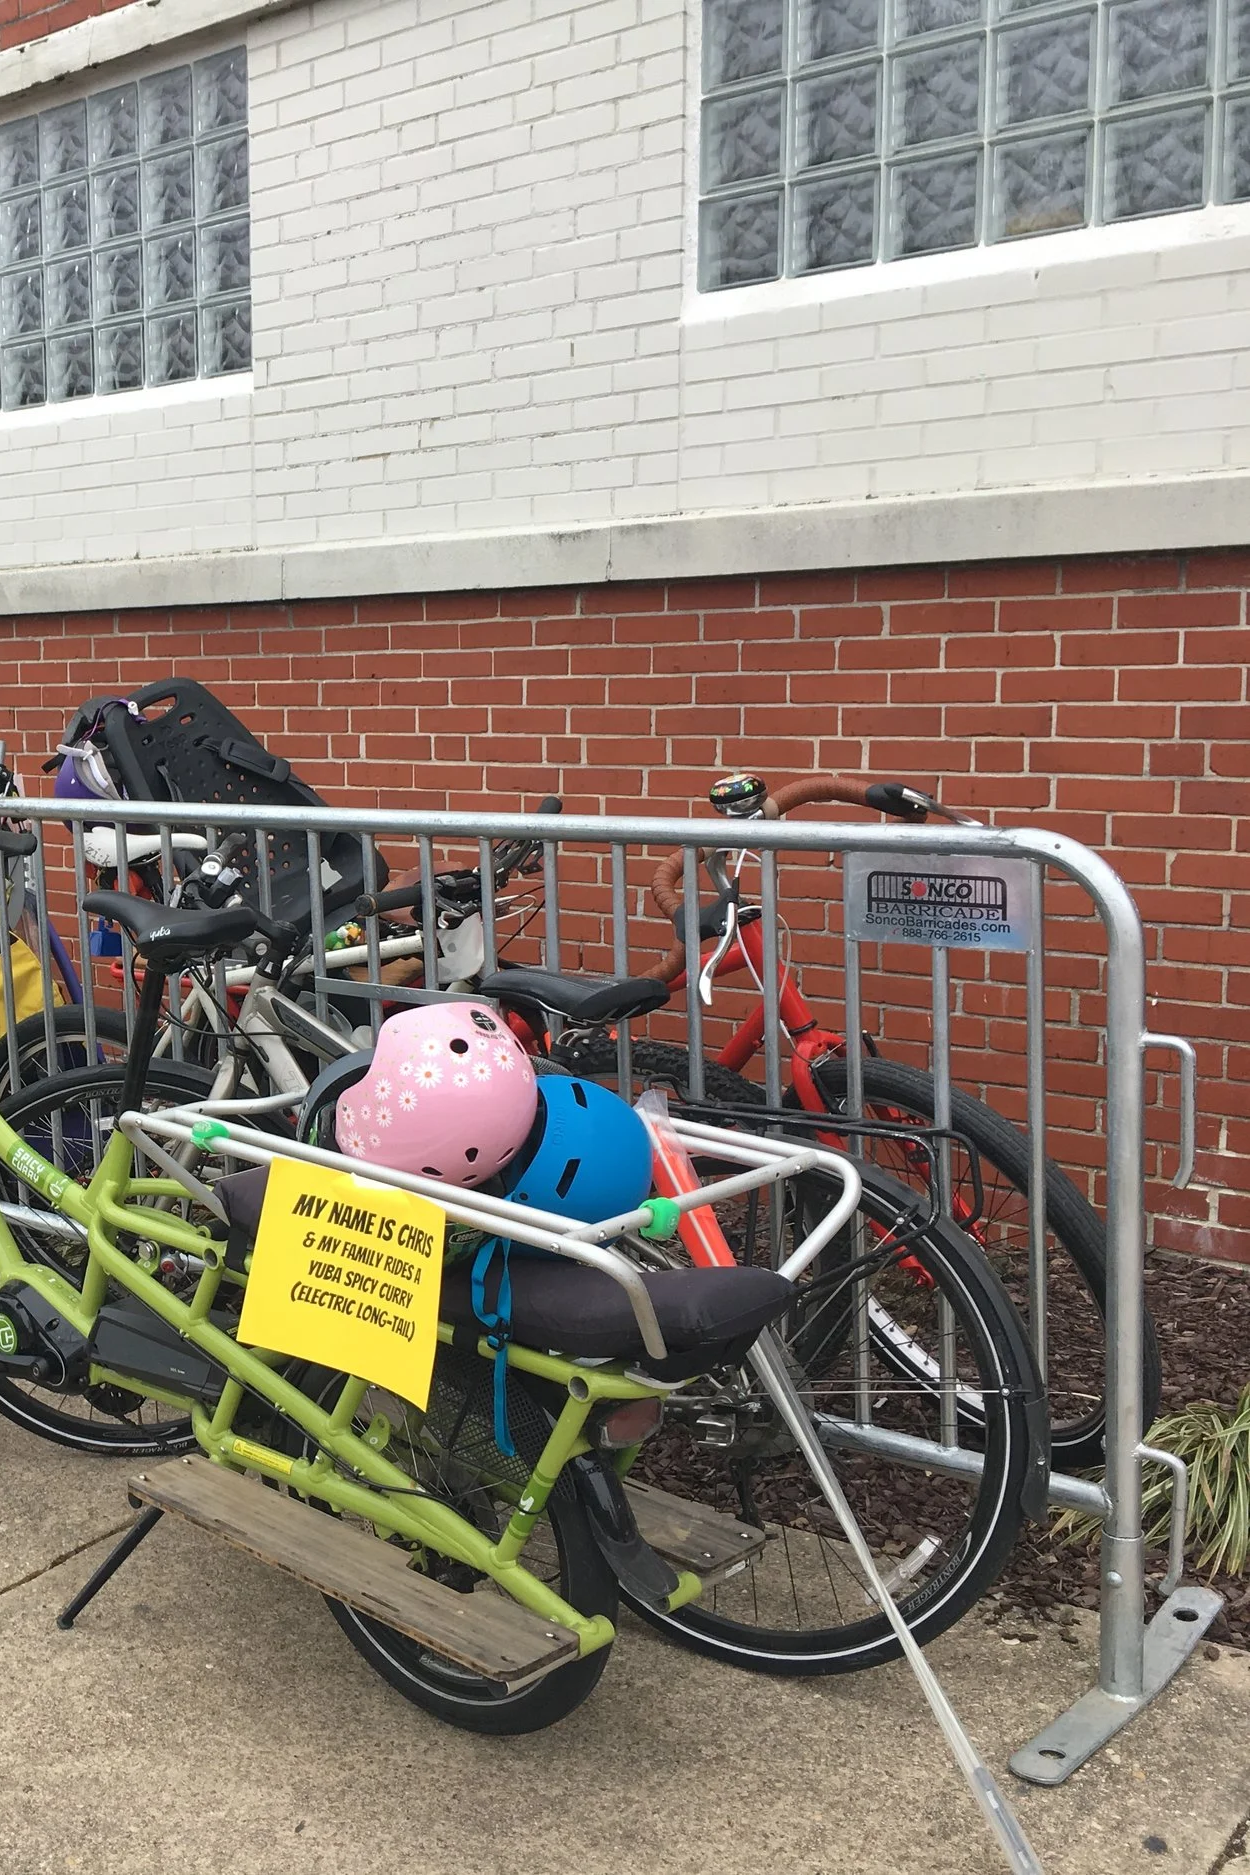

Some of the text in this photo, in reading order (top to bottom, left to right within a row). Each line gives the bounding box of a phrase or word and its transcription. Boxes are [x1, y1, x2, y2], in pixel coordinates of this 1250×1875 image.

[865, 914, 1011, 934] SoncoBarricades.com
[876, 902, 1000, 921] BARRICADE
[150, 926, 170, 941] yuba
[902, 928, 982, 943] 888-766-2615
[11, 1156, 41, 1183] CURRY
[14, 1148, 46, 1174] SPICY
[292, 1194, 434, 1258] MY NAME IS CHRIS
[302, 1231, 422, 1285] & MY FAMILY RIDES A
[308, 1260, 413, 1308] YUBA SPICY CURRY
[291, 1281, 416, 1342] (ELECTRIC LONG-TAIL)
[908, 1554, 961, 1611] BONTRAGER
